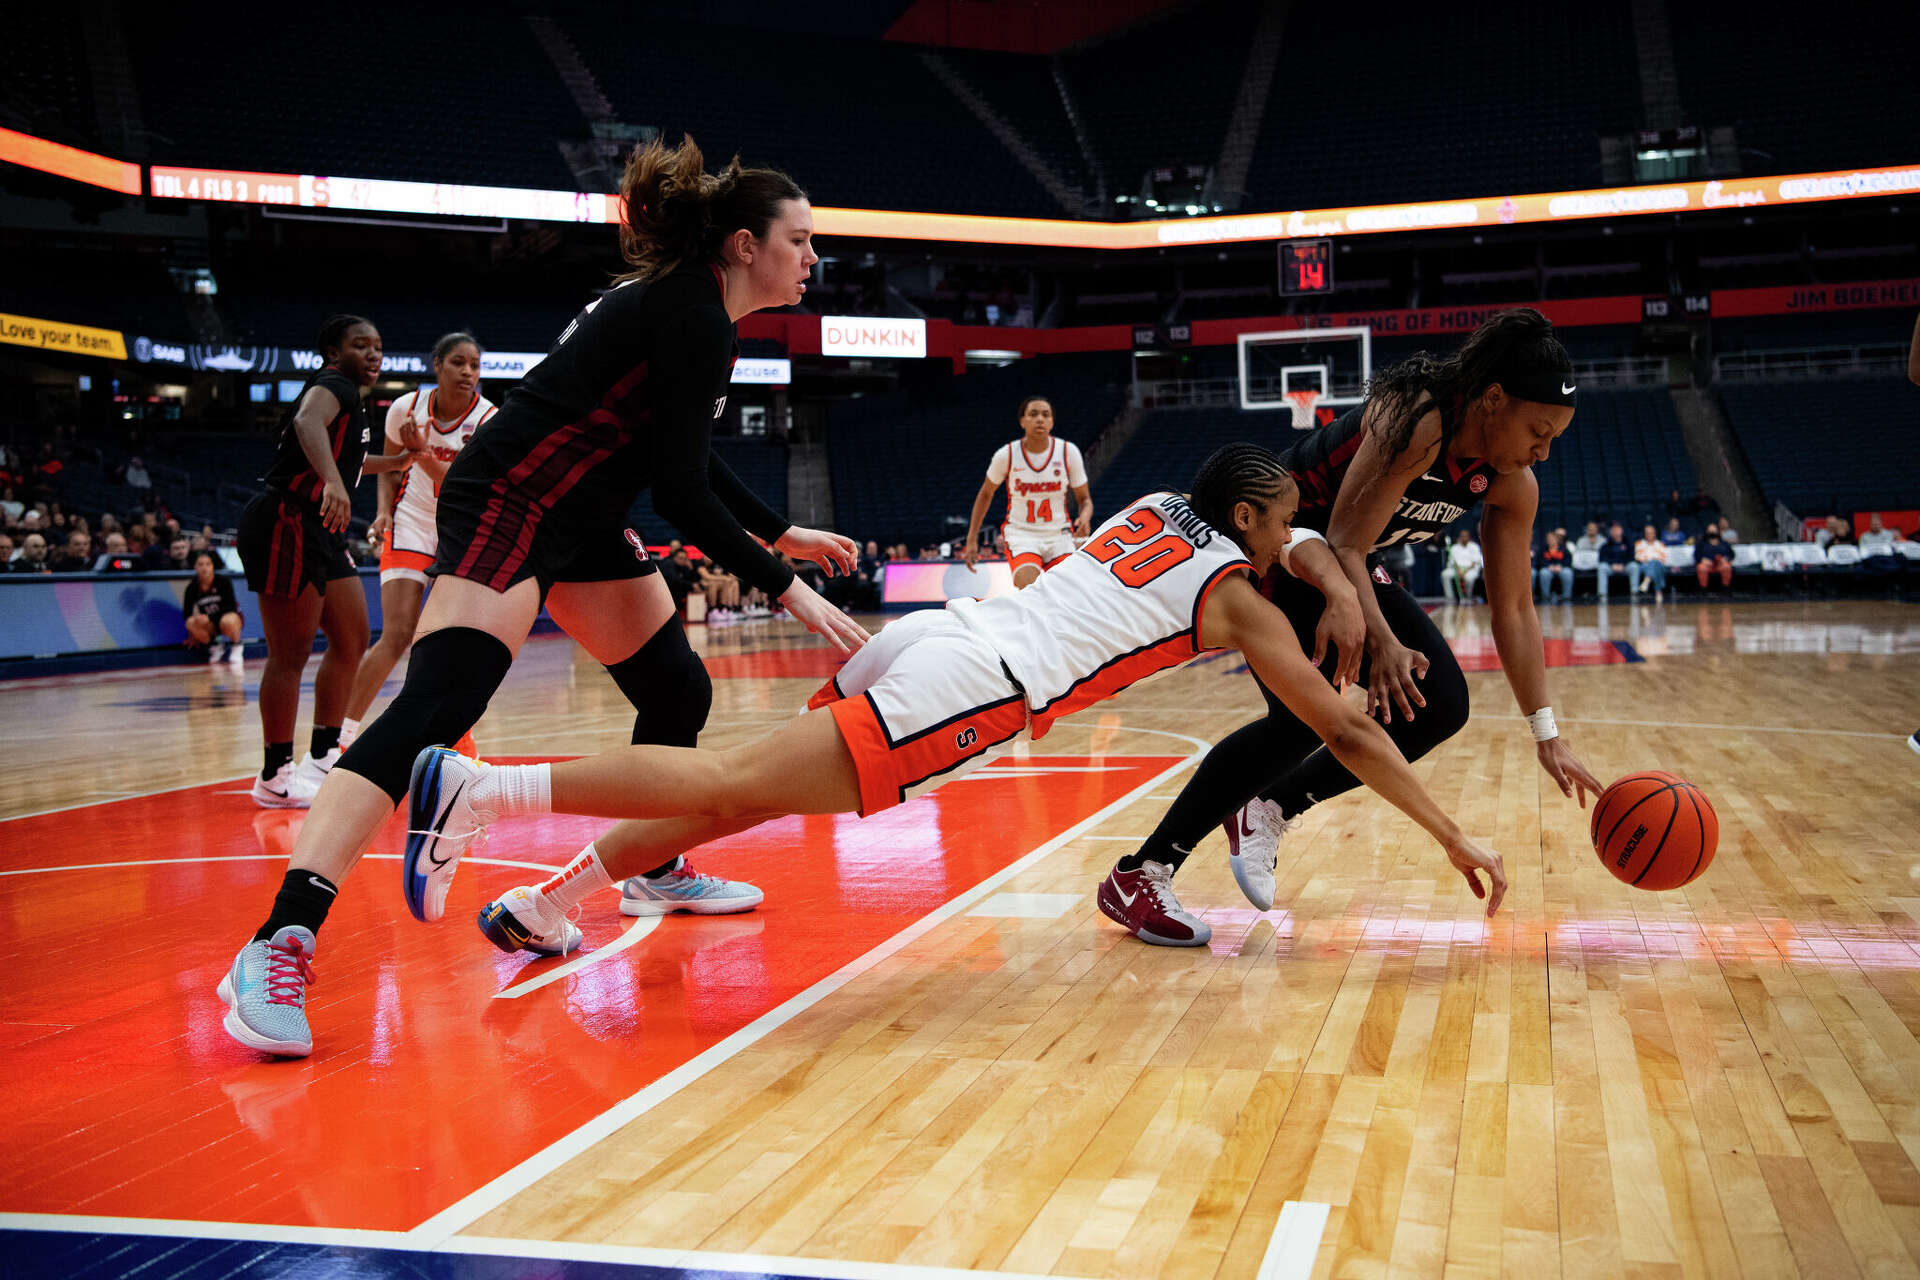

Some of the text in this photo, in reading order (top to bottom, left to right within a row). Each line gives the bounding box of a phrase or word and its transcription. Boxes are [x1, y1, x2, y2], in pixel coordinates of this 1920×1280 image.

[1299, 262, 1324, 290] 14
[1685, 296, 1708, 312] 114
[1785, 284, 1920, 308] JIM BOEHEI
[0, 318, 114, 351] Love your team.
[1405, 313, 1433, 331] OF
[827, 327, 920, 347] DUNKIN'
[1026, 498, 1053, 524] 14
[1081, 507, 1196, 590] 20
[956, 726, 978, 749] S
[1616, 823, 1649, 870] SYRACUSE
